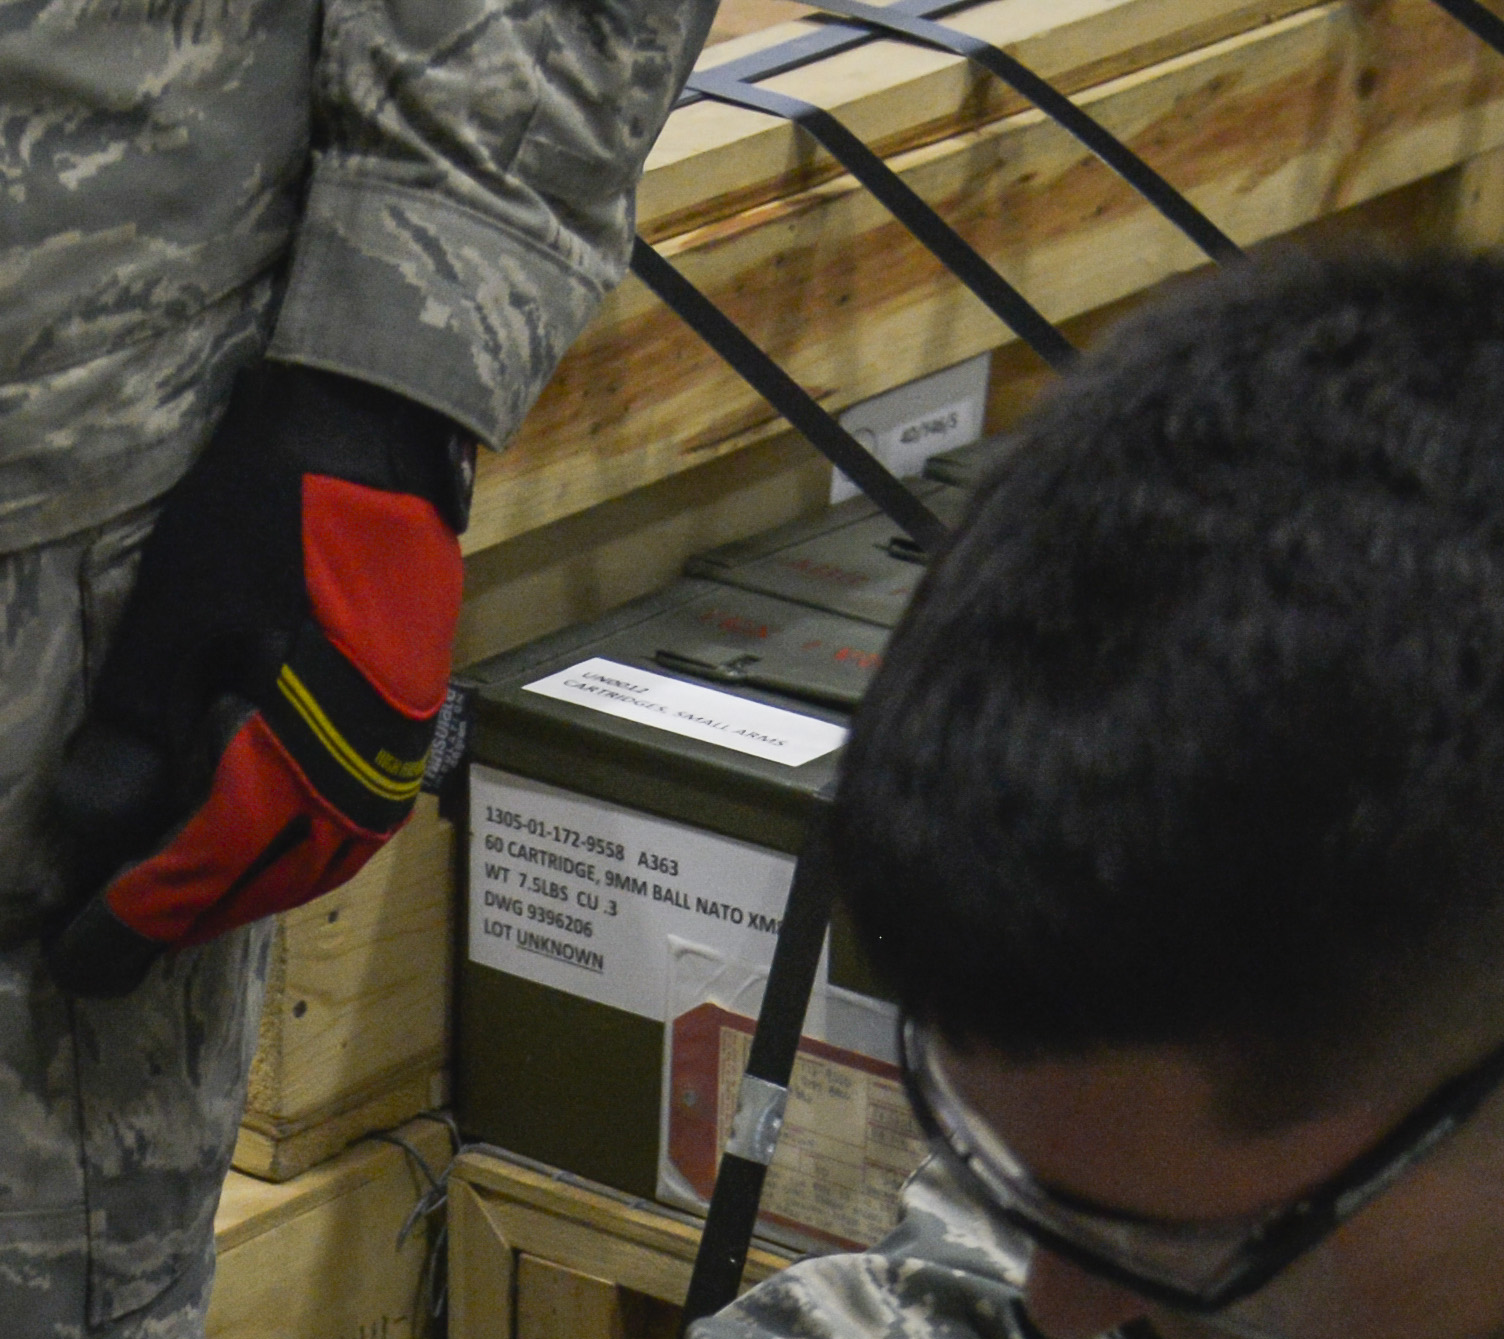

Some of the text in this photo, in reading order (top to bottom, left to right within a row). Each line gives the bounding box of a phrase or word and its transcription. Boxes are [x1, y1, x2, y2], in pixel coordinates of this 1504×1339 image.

[673, 709, 731, 732] SMALL
[731, 727, 788, 748] ARMS
[485, 805, 679, 876] 1305-01-172-9558 A363
[484, 833, 504, 854] 60
[506, 839, 600, 886] CARTRIDGE,
[604, 870, 648, 897] 9MM
[652, 883, 691, 910] BALL
[695, 896, 743, 925] NATO
[484, 862, 509, 884] WT
[518, 872, 569, 902] 7.5LBS
[576, 890, 599, 911] CU
[483, 890, 593, 937] DWG 9396206
[482, 917, 605, 972] LOT UNKNOWN
